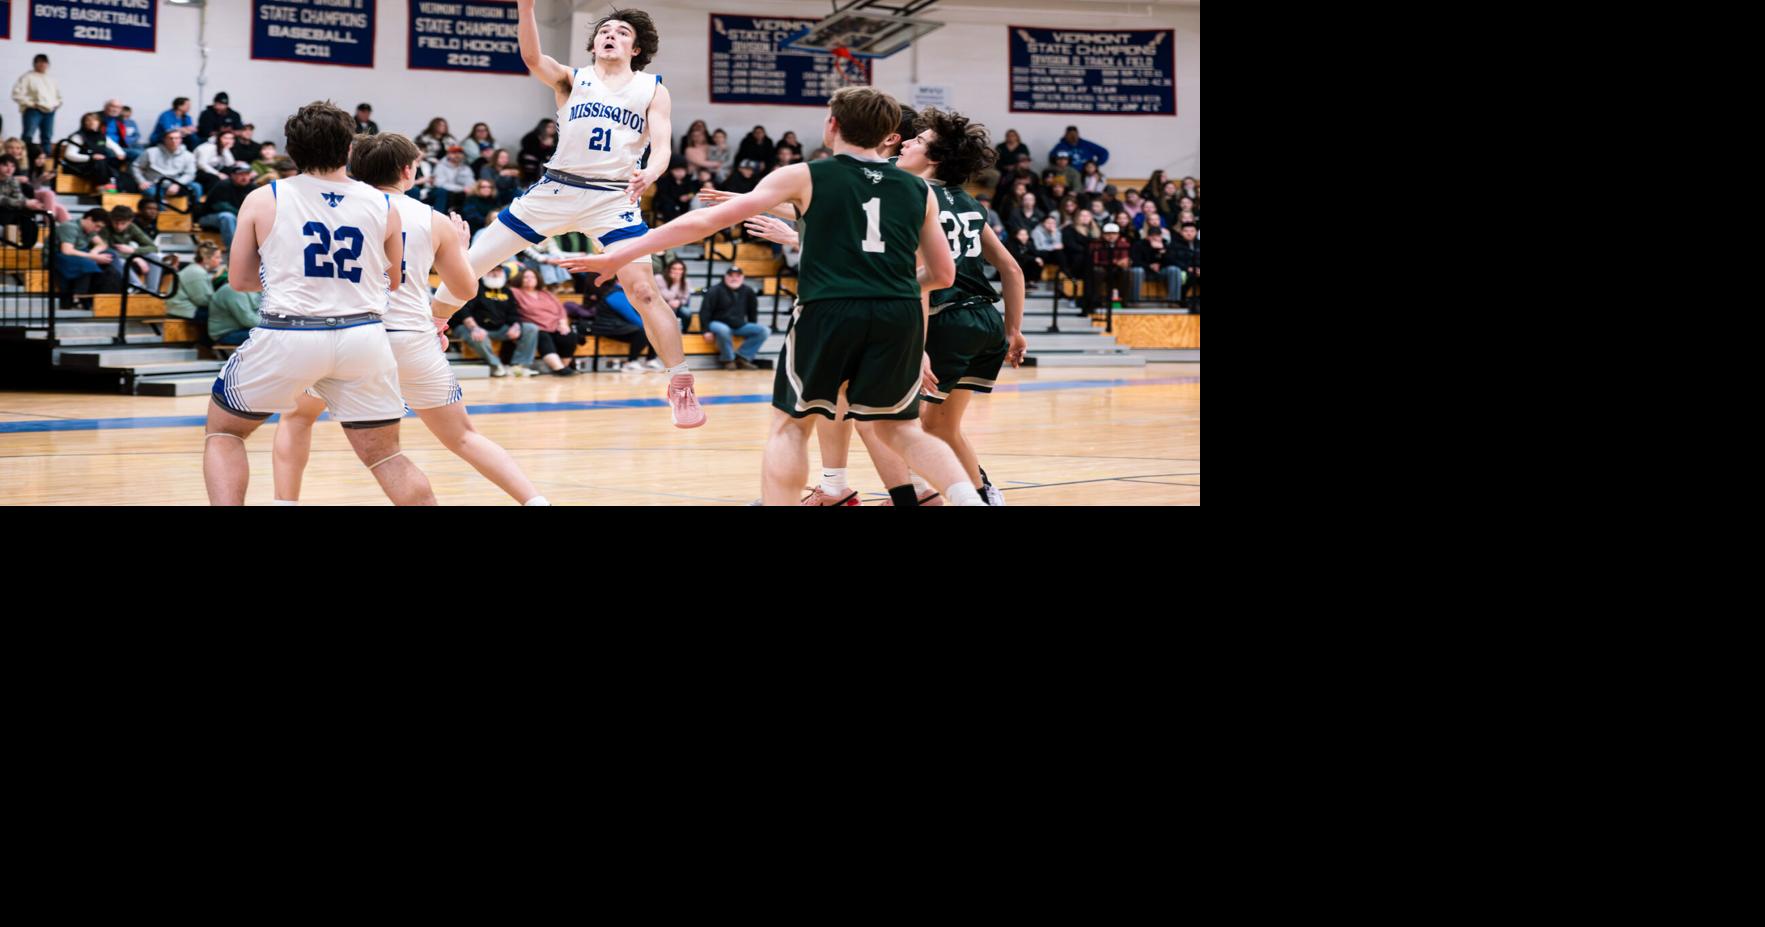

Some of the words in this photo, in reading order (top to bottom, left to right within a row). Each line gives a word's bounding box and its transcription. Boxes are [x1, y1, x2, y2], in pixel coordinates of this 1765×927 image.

[34, 4, 67, 19] BOYS
[70, 8, 151, 27] BASKETBALL
[260, 5, 298, 22] STATE
[300, 9, 368, 28] CHAMPIONS
[419, 2, 462, 15] VERMONT
[465, 5, 504, 18] DIVISION
[73, 25, 112, 41] 2011
[267, 24, 358, 44] BASEBALL
[415, 17, 453, 34] STATE
[728, 29, 769, 41] STATE
[1052, 32, 1131, 44] VERMONT
[294, 43, 330, 58] 2011
[418, 36, 460, 49] FIELD
[463, 39, 518, 53] HOCKEY
[1027, 42, 1072, 54] STATE
[1075, 45, 1157, 56] CHAMPIONS
[447, 53, 491, 67] 2012
[1084, 57, 1114, 67] TRACK
[1125, 57, 1153, 67] FIELD
[569, 102, 645, 134] MISSISQUOI
[588, 127, 612, 152] 21
[861, 197, 886, 254] 1
[939, 210, 984, 259] 35
[302, 221, 365, 284] 22
